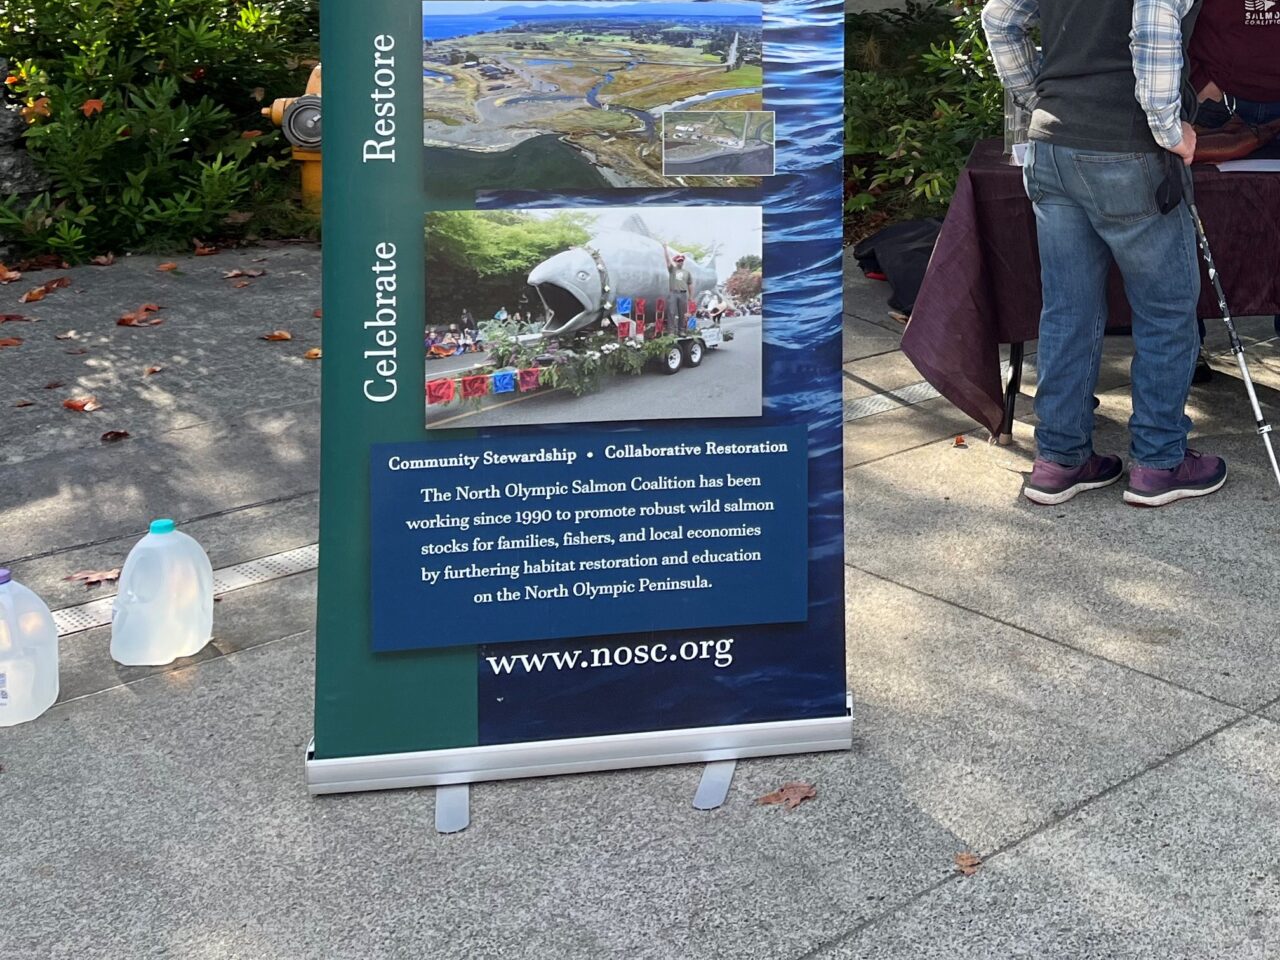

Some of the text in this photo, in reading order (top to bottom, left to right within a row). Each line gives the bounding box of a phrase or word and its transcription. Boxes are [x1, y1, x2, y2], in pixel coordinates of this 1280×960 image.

[363, 34, 396, 163] Restore
[363, 242, 398, 403] Celebrate
[388, 440, 789, 470] Community Stewardship Collaborative Restoration
[420, 473, 762, 503] The North Olympic Salmon Coalition has been
[405, 497, 775, 530] working since 1990 to promote robust wild salmon
[421, 524, 762, 554] stocks for families, fishers, and local economies
[420, 548, 762, 584] by furthering habitat restoration and education
[473, 574, 713, 604] on the North Olympic Peninsula.
[485, 635, 734, 674] www.nosc.org
